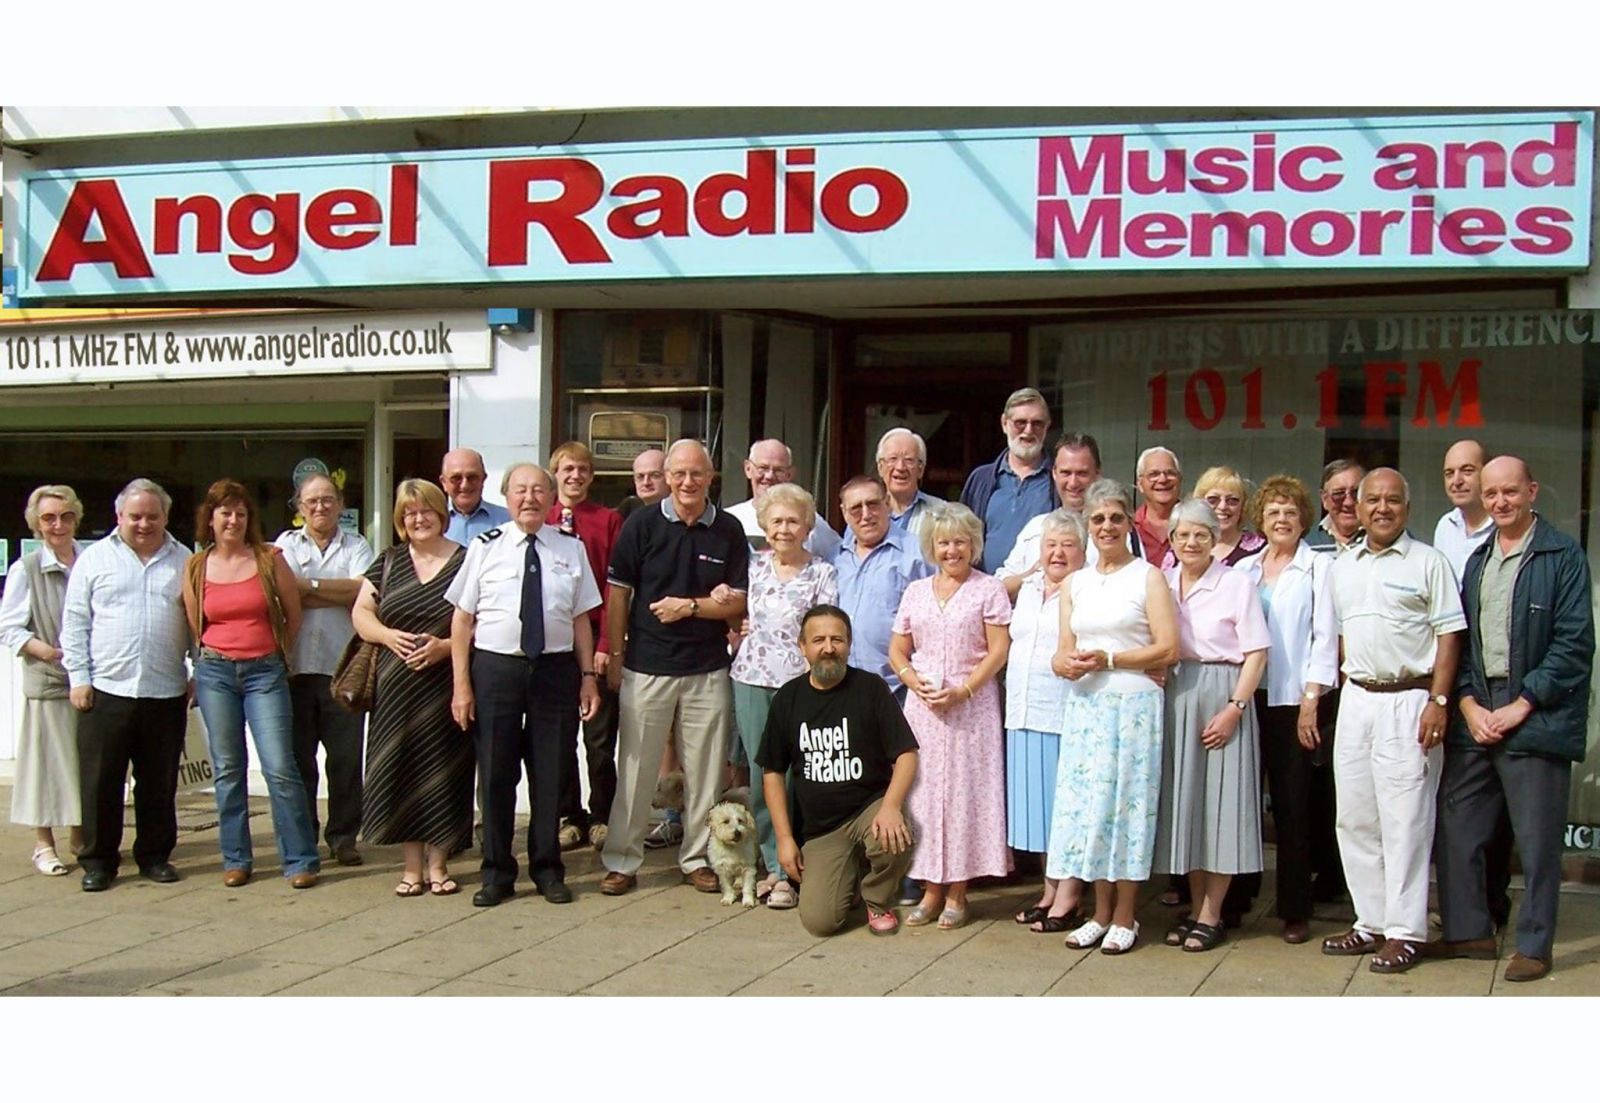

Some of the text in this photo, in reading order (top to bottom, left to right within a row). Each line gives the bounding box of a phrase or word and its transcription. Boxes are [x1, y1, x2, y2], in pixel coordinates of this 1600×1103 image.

[1037, 121, 1578, 196] Music and
[35, 147, 909, 282] Angel Radio
[1035, 193, 1574, 259] Memories
[6, 321, 452, 370] 101.1 MHz FM & www.angelradio.co.uk
[1239, 319, 1329, 357] WITH
[1339, 318, 1366, 354] A
[1147, 358, 1485, 431] 101.1 FM
[799, 717, 850, 760] Angel
[811, 749, 863, 783] Radio
